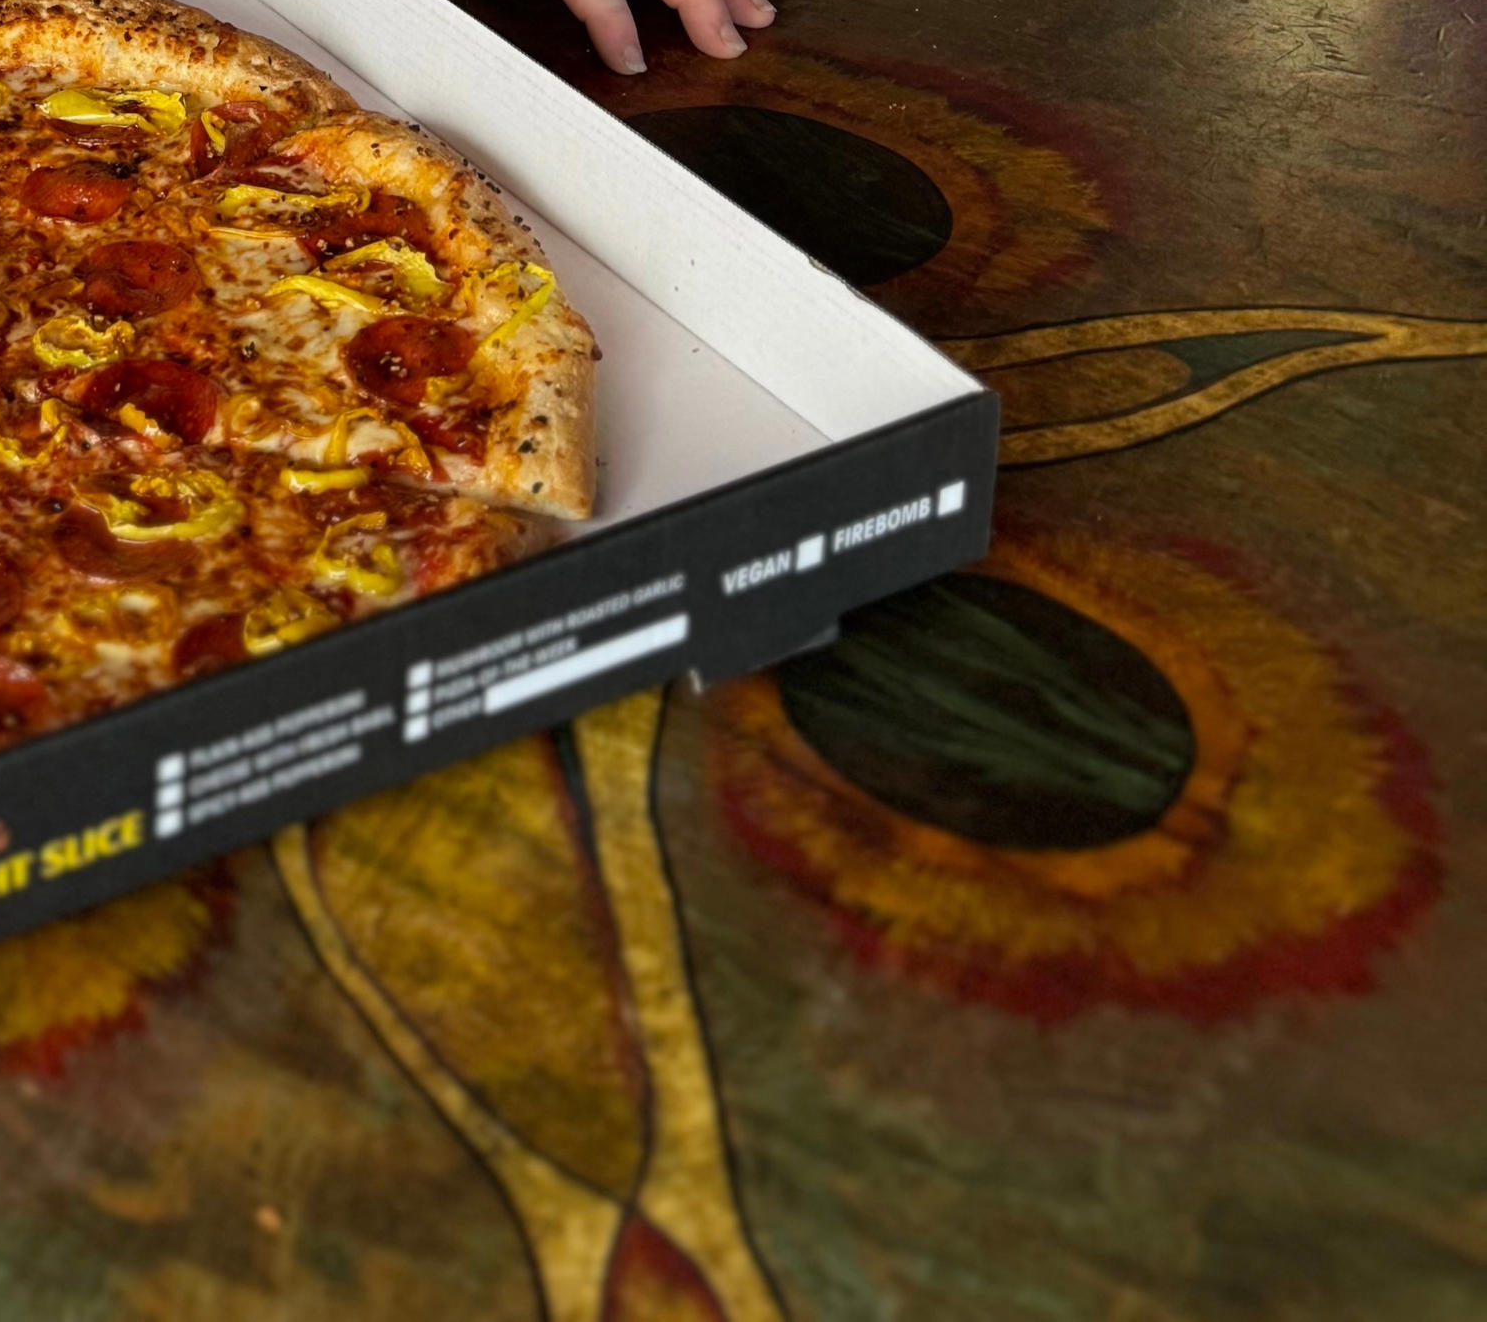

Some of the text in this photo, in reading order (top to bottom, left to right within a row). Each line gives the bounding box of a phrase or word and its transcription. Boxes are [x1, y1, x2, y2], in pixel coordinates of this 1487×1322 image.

[723, 497, 931, 596] VEGAN FIREBOMB
[566, 592, 630, 629] ROASTED
[632, 572, 685, 606] GARLIC
[40, 810, 144, 878] SLICE
